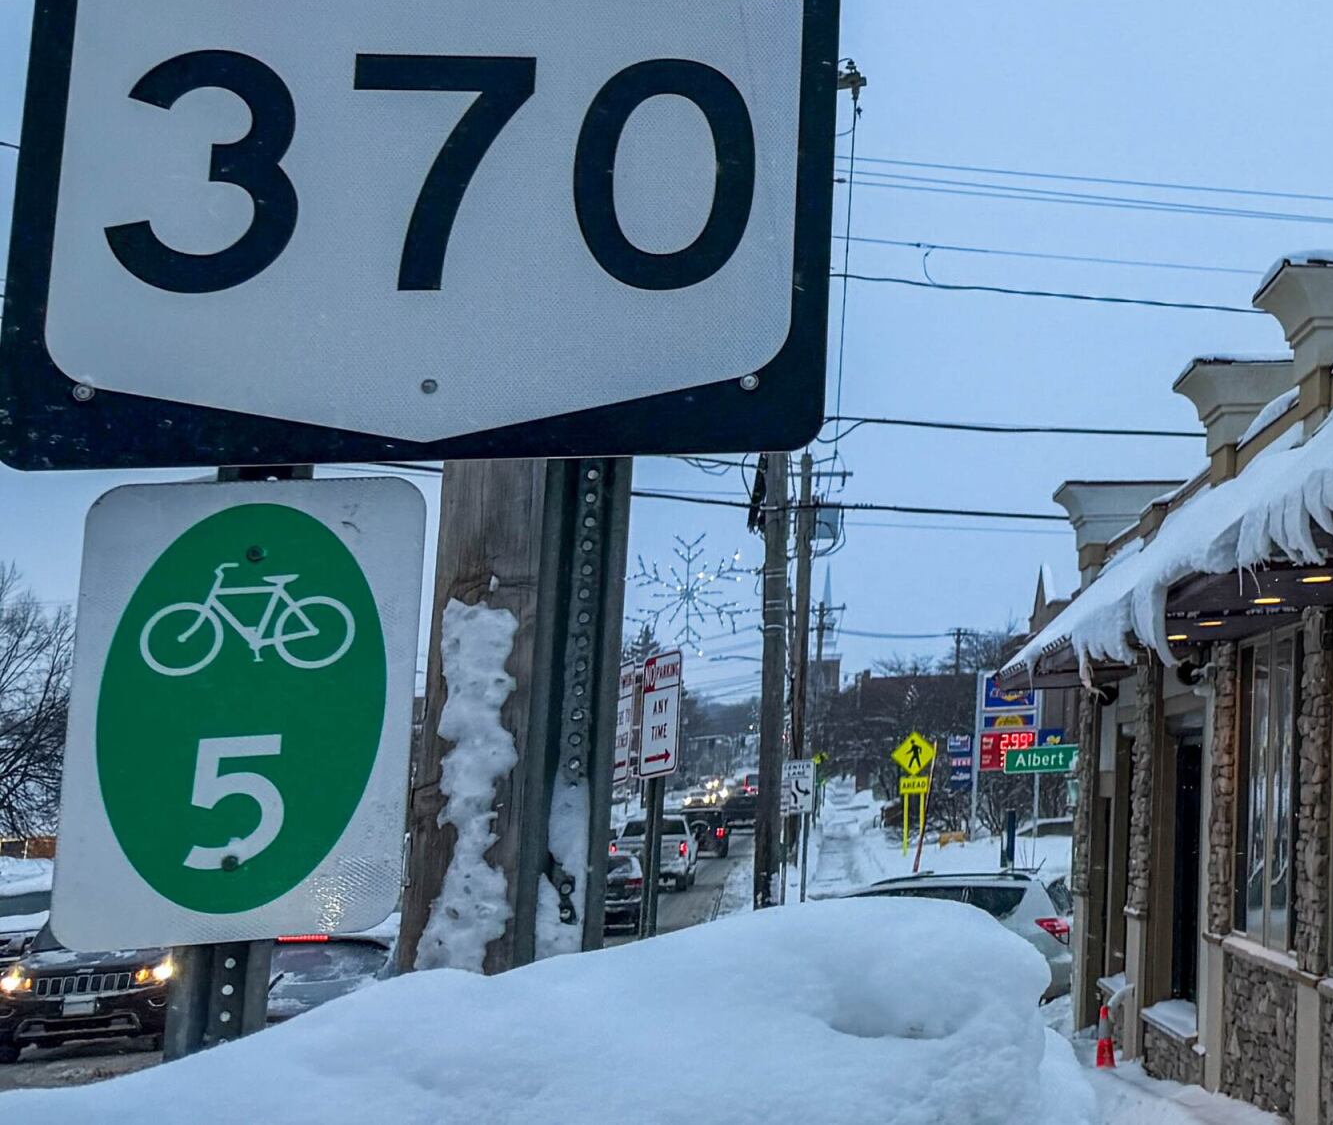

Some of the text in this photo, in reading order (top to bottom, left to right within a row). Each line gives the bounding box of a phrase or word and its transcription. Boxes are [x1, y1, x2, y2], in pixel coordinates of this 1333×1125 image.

[104, 50, 756, 294] 370
[645, 665, 655, 686] NO
[656, 662, 679, 680] PARKING
[653, 697, 668, 715] ANY
[651, 723, 667, 741] TIME
[1015, 752, 1064, 767] Albert
[902, 781, 926, 790] AHEAD
[182, 734, 285, 871] 5
